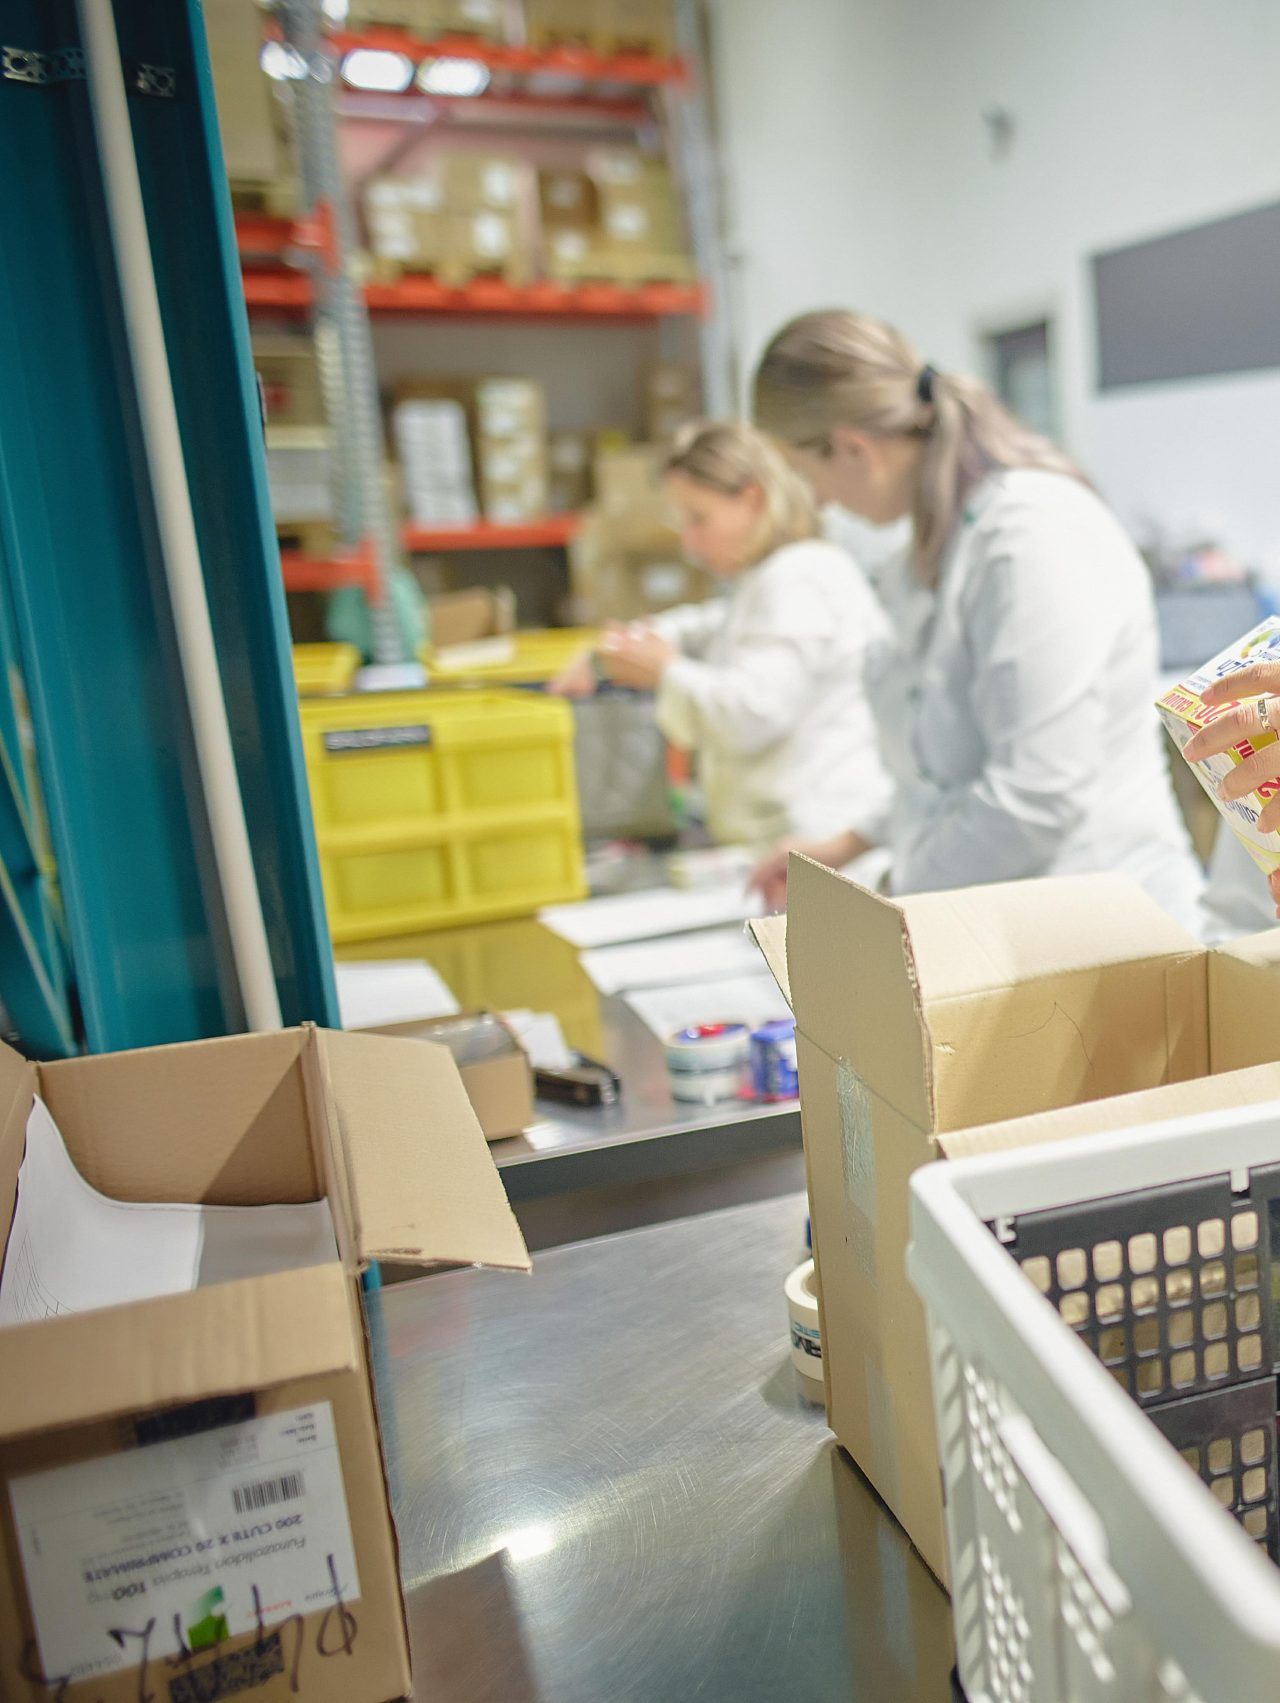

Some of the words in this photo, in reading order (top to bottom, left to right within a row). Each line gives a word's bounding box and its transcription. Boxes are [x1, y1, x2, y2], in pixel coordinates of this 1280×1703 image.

[1161, 693, 1193, 711] CADOU
[1232, 739, 1255, 760] ni
[274, 1514, 302, 1531] 200
[194, 1537, 215, 1552] 20
[214, 1536, 306, 1570] Furazolidon
[83, 1544, 192, 1582] COMPRIMATE
[152, 1561, 210, 1588] Terapia
[112, 1580, 146, 1601] 100
